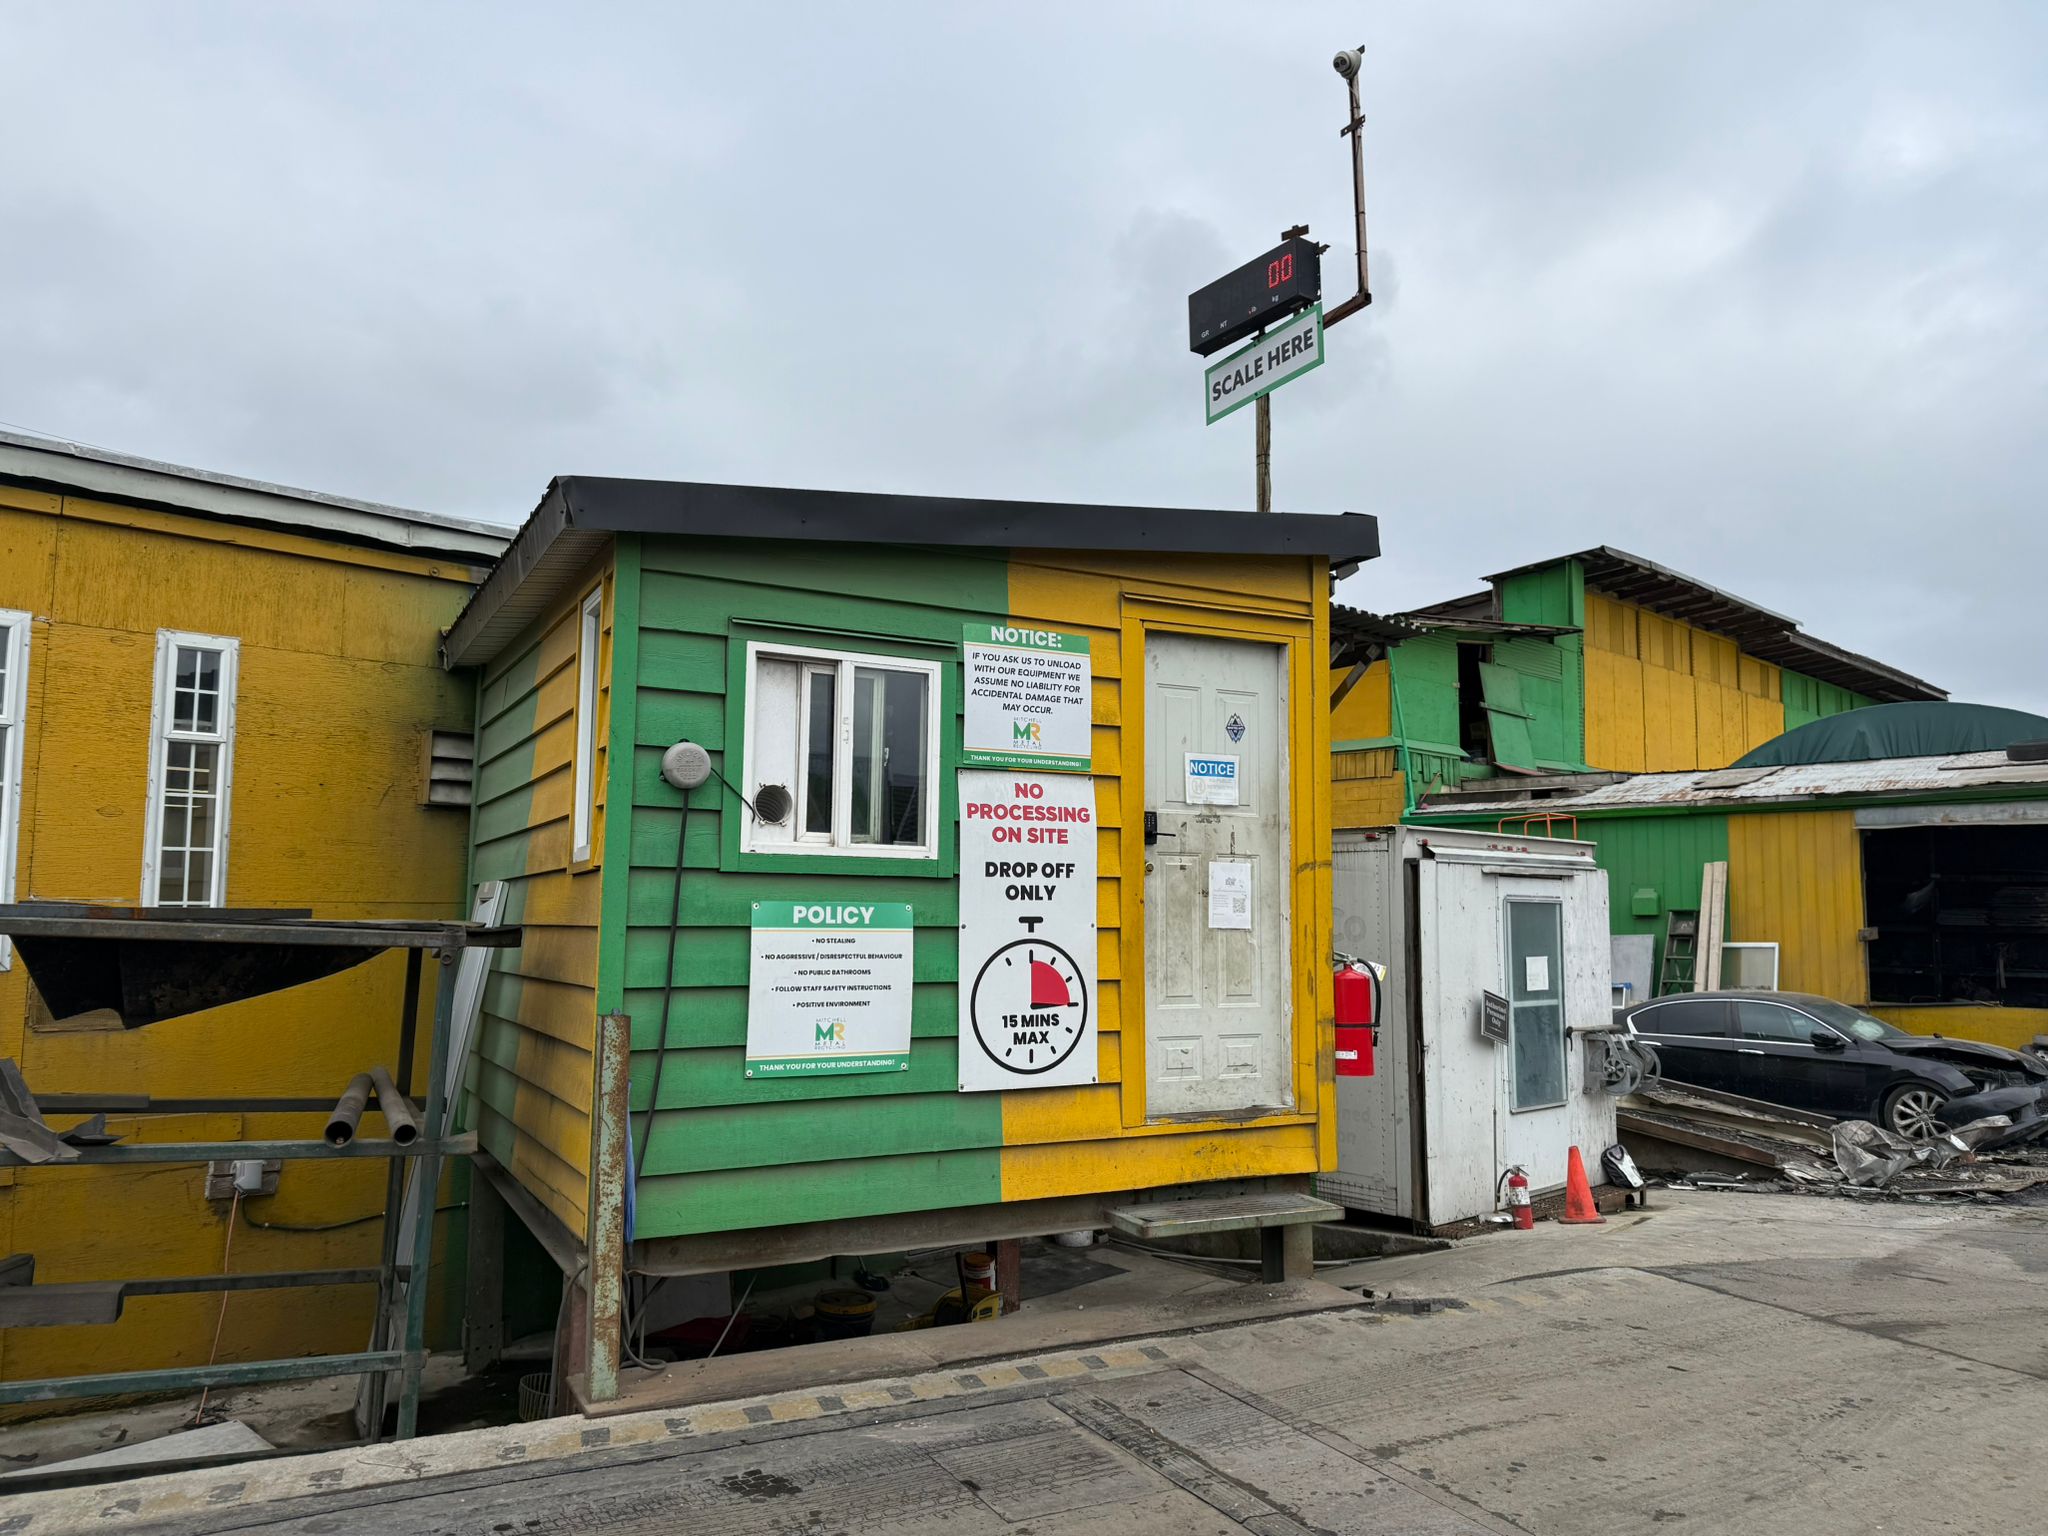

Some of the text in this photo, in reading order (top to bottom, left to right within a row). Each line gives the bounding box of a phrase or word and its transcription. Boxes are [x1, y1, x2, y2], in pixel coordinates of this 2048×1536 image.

[1212, 327, 1314, 402] SCALE HERE
[991, 625, 1062, 648] NOTICE:
[972, 652, 1082, 670] IF YOU ASK US TO UNLOAD
[974, 664, 1081, 682] WITH OUR EQUIPMENT WE
[974, 676, 1081, 693] ASSUME NO LIABILITY FOR
[971, 688, 1083, 705] ACCIDENTAL DAMAGE THAT
[1002, 703, 1053, 715] MAY OCCUR.
[971, 754, 990, 762] THANK
[991, 755, 1005, 763] YOU
[1033, 758, 1082, 767] UNDERSTANDING!
[1190, 761, 1235, 776] NOTICE
[1014, 782, 1044, 800] NO
[966, 802, 1090, 824] PROCESSING
[991, 826, 1069, 845] ON SITE
[984, 861, 1075, 879] DROP OFF
[1005, 884, 1057, 901] ONLY
[792, 905, 875, 925] POLICY
[826, 1000, 871, 1008] ENVIRONMENT
[1002, 1013, 1060, 1028] 15 MINS
[1013, 1031, 1050, 1046] MAX
[759, 1064, 785, 1072] THANK
[817, 1061, 836, 1069] YOUR
[836, 1059, 895, 1068] UNDERSTANDING!
